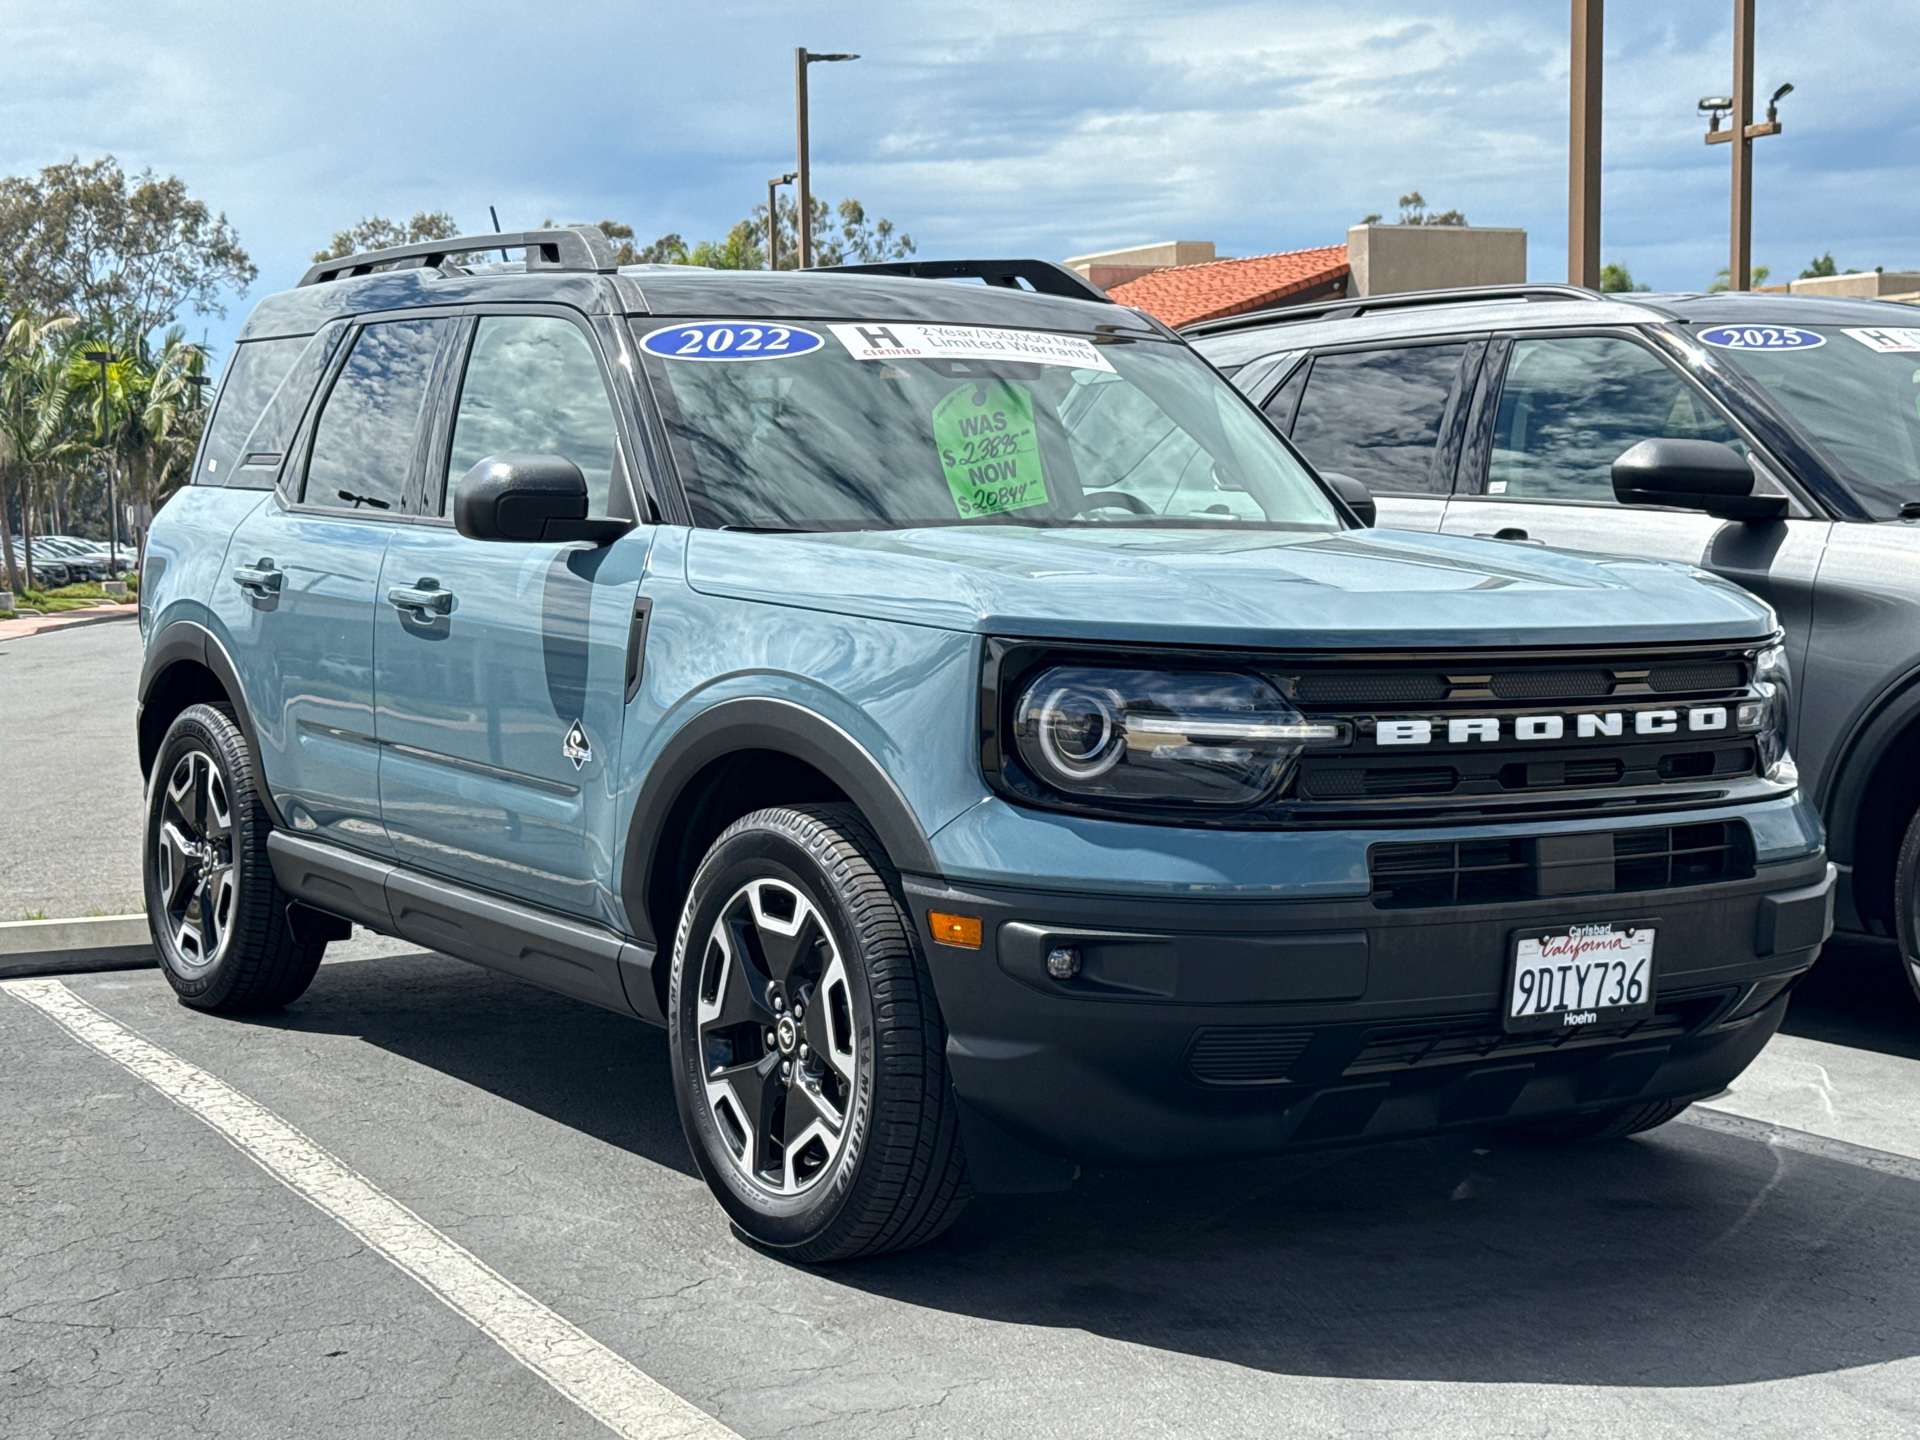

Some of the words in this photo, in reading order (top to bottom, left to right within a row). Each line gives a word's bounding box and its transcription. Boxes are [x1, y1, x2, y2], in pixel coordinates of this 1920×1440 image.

[675, 327, 791, 355] 2022
[854, 326, 905, 349] H
[926, 336, 1007, 351] Limited
[1005, 340, 1099, 363] Warranty
[1051, 337, 1091, 350] Mile
[1722, 329, 1803, 346] 2025
[1859, 330, 1902, 345] H
[862, 347, 922, 357] CERTIFIED
[958, 411, 1008, 438] WAS
[968, 459, 1017, 487] NOW
[1376, 706, 1728, 746] BRONCO
[1569, 923, 1612, 938] Carlsbad
[671, 895, 696, 1004] MICHELIN
[1541, 935, 1631, 962] California
[1516, 957, 1647, 1016] 9DIY736
[1563, 1011, 1597, 1026] Hoehn
[836, 1073, 869, 1195] MICHELIN
